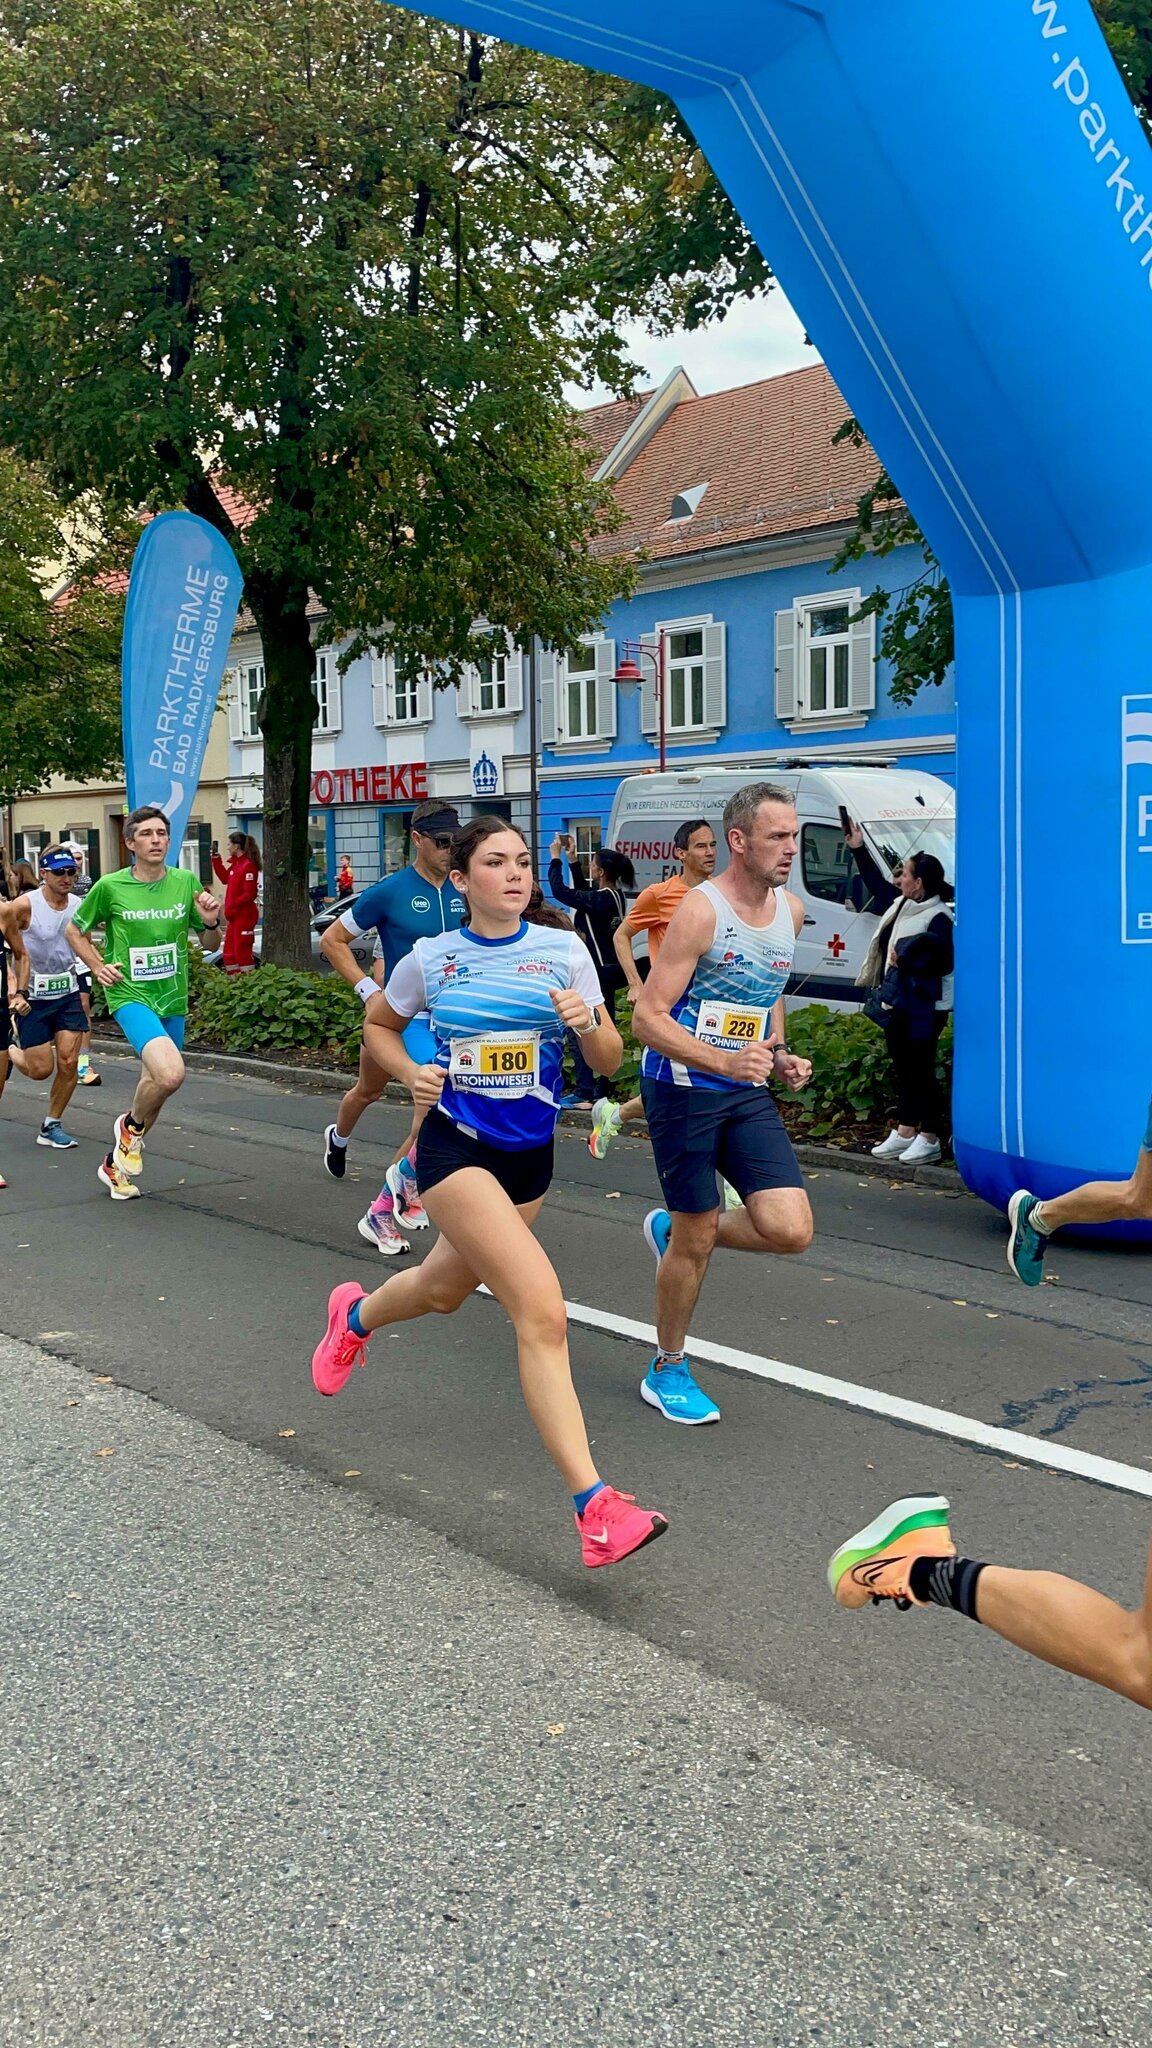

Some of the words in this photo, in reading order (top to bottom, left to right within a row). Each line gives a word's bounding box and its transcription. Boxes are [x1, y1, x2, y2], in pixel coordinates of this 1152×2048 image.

[1032, 0, 1152, 290] w.parkth
[182, 574, 229, 728] RADKERSBURG
[149, 564, 210, 770] PARKTHERME
[173, 733, 192, 775] BAD
[310, 763, 428, 804] OTHEKE
[122, 908, 174, 920] merkur
[151, 954, 169, 966] 331
[51, 980, 67, 990] 313
[728, 1020, 755, 1038] 228
[700, 1034, 749, 1049] FROHNWIES
[488, 1051, 528, 1071] 180
[456, 1074, 533, 1087] FROHNWIESER
